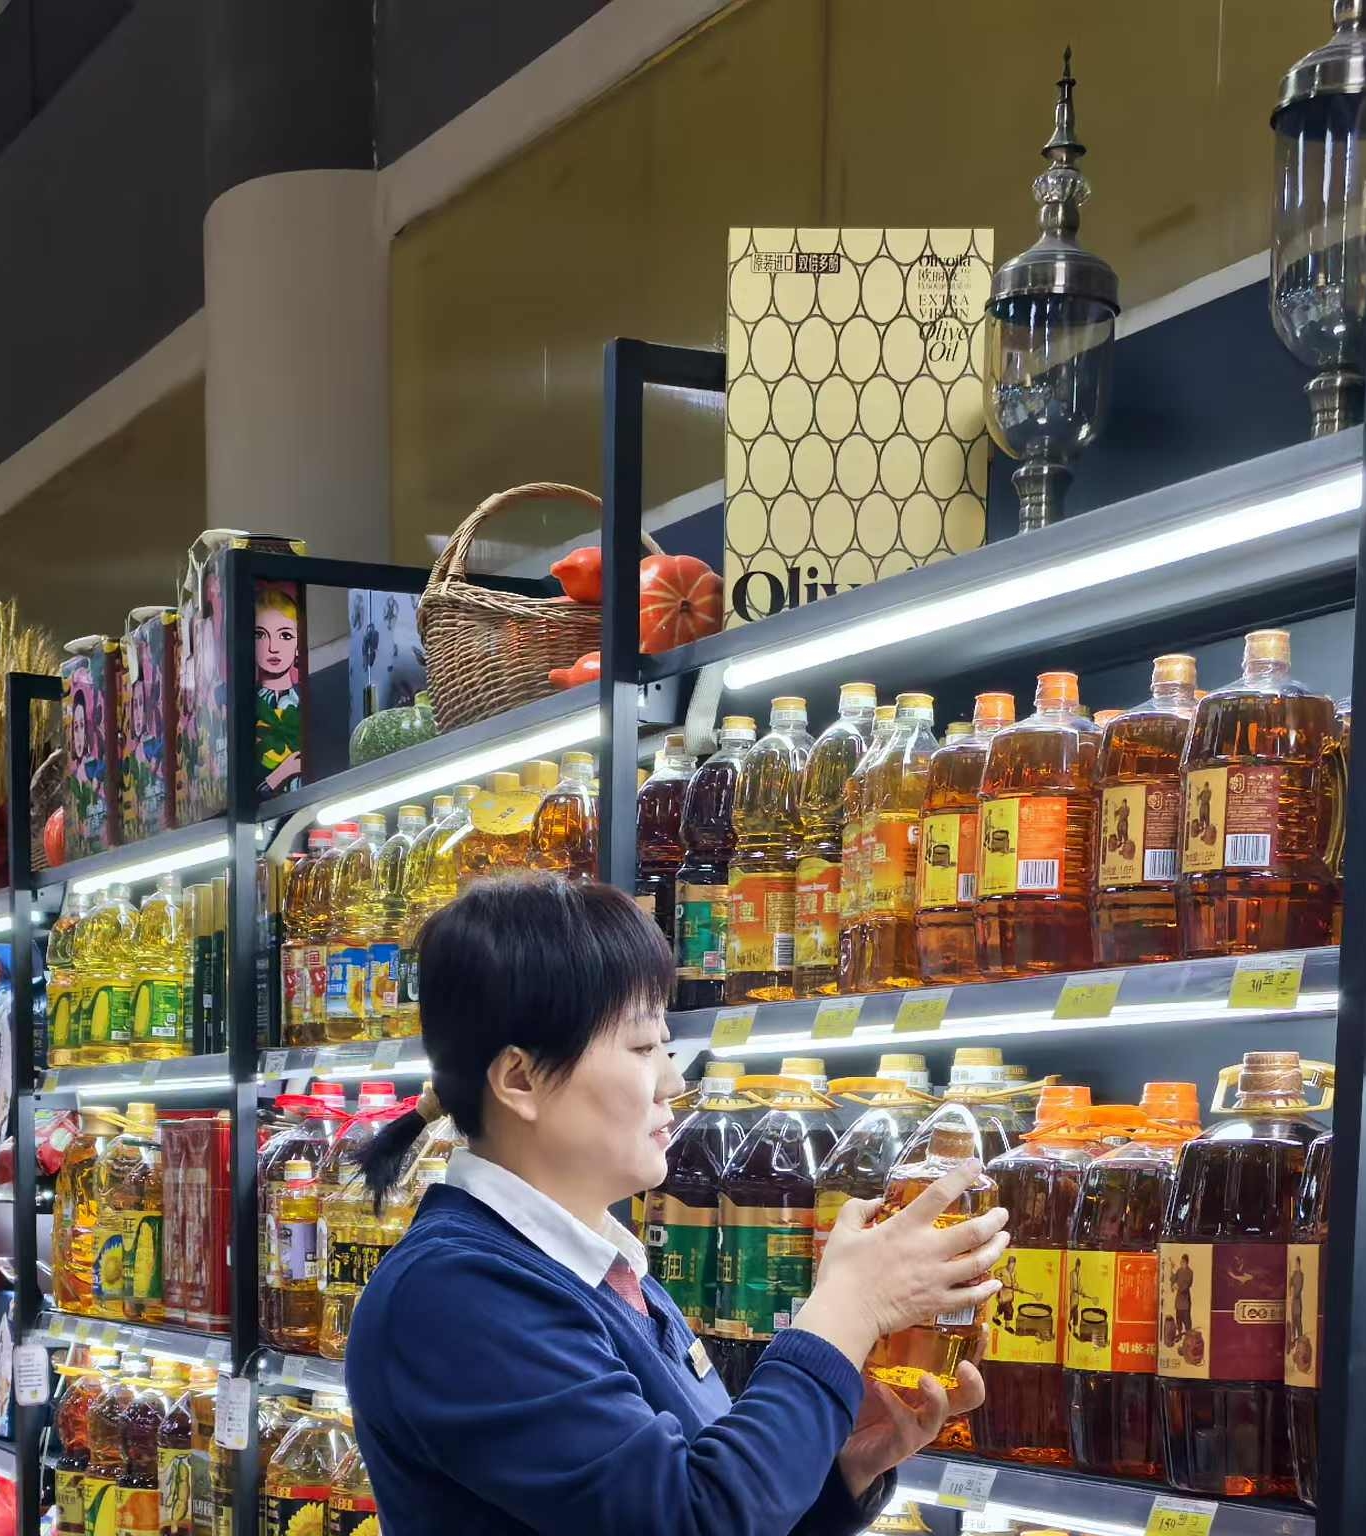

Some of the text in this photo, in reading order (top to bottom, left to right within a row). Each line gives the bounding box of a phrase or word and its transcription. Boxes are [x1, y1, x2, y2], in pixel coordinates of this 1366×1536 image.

[918, 293, 970, 307] EXTRA
[918, 321, 970, 341] Olive
[929, 341, 959, 362] Oil
